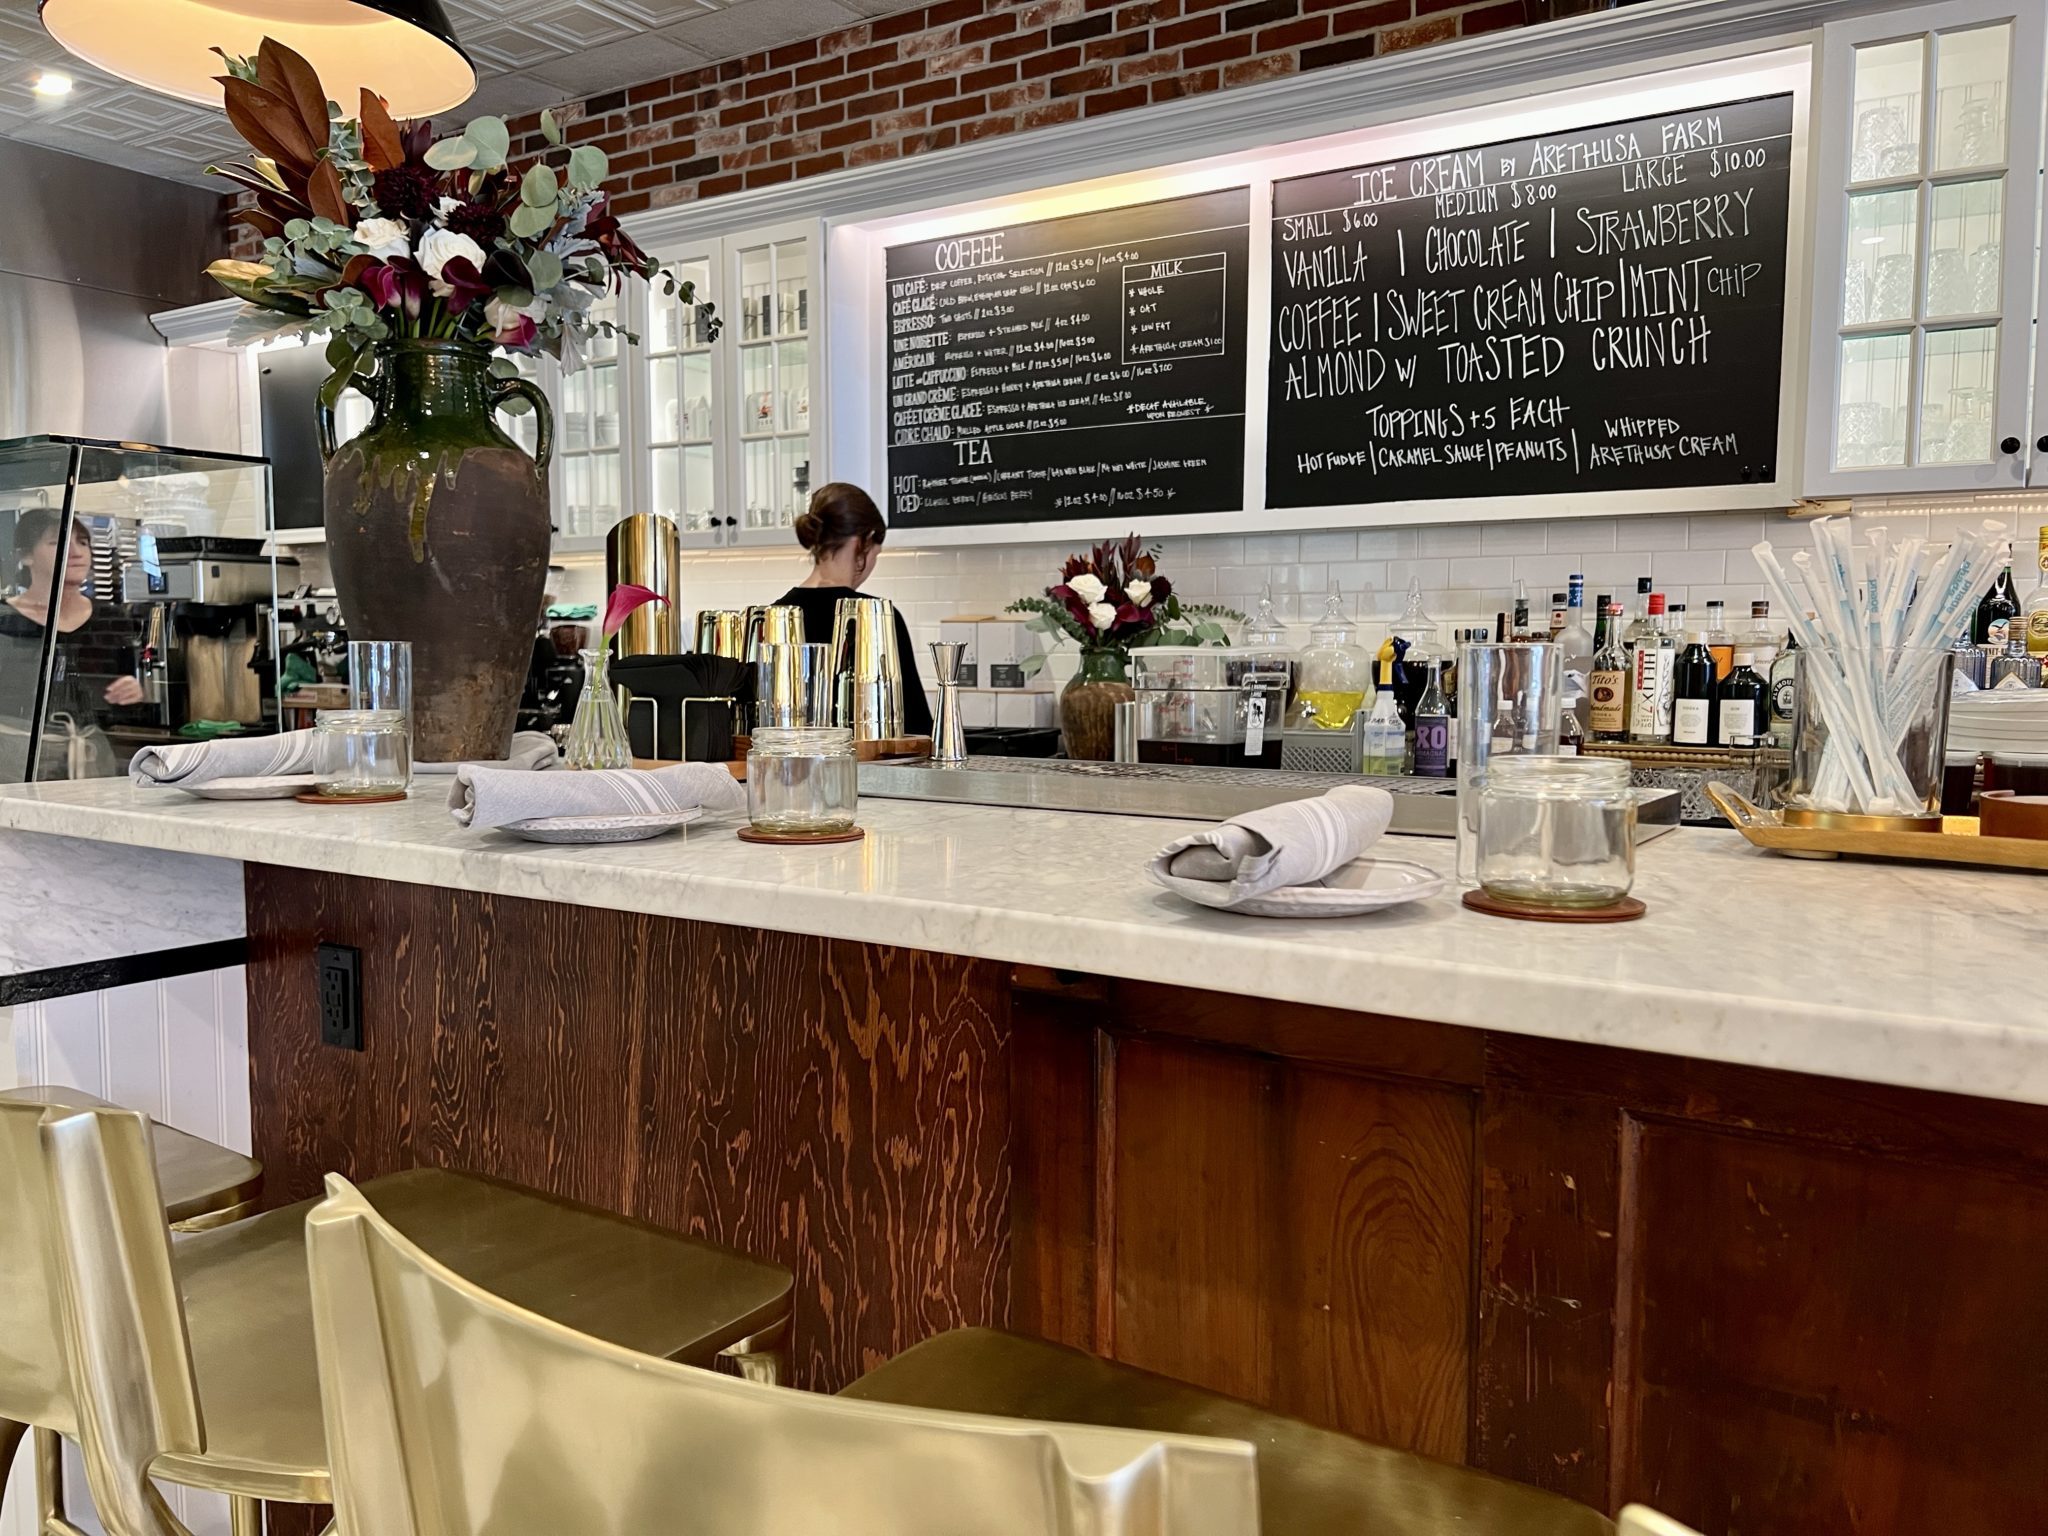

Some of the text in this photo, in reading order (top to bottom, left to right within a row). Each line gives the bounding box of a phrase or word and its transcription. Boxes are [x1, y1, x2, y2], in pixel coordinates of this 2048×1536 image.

[1351, 166, 1398, 206] ICE
[1409, 150, 1485, 198] CREAM
[1528, 132, 1642, 176] ARETHUSA
[1661, 115, 1723, 154] FARM
[1621, 154, 1687, 194] LARGE
[1435, 183, 1499, 220] MEDIUM
[1282, 213, 1332, 242] SMALL
[1282, 187, 1754, 290] VANILLA CHOCOLATE STRAWBERRY
[935, 232, 1005, 272] COFFEE
[1008, 267, 1045, 278] SELECTION
[1150, 260, 1183, 279] MILK
[1137, 285, 1165, 297] WHOLE
[1278, 295, 1362, 353] COFFEE
[1386, 288, 1466, 341] SWEET
[1473, 277, 1546, 331] CREAM
[1553, 271, 1615, 324] CHIP
[1629, 255, 1712, 319] MINT
[1139, 302, 1157, 314] OAT
[1141, 321, 1172, 332] LOW FAT
[1178, 337, 1204, 349] CREAM
[1284, 348, 1386, 401] ALMOND
[1437, 333, 1565, 384] TOASTED
[1591, 314, 1711, 372] CRUNCH
[970, 366, 1003, 378] ESPRESSO
[961, 386, 993, 399] ESPRESSO
[1146, 412, 1165, 420] UPON
[1365, 403, 1465, 441] TOPPINGS
[1509, 395, 1571, 431] EACH
[953, 439, 993, 466] TEA
[1152, 459, 1181, 470] JASMINE
[1183, 457, 1208, 468] GREEN
[1297, 437, 1567, 474] HOT FUDGE CARAMEL SAUCE PEANUTS
[1589, 432, 1738, 470] ARETHUSA CREAM
[1591, 674, 1619, 686] Tito's
[1416, 725, 1447, 750] XO
